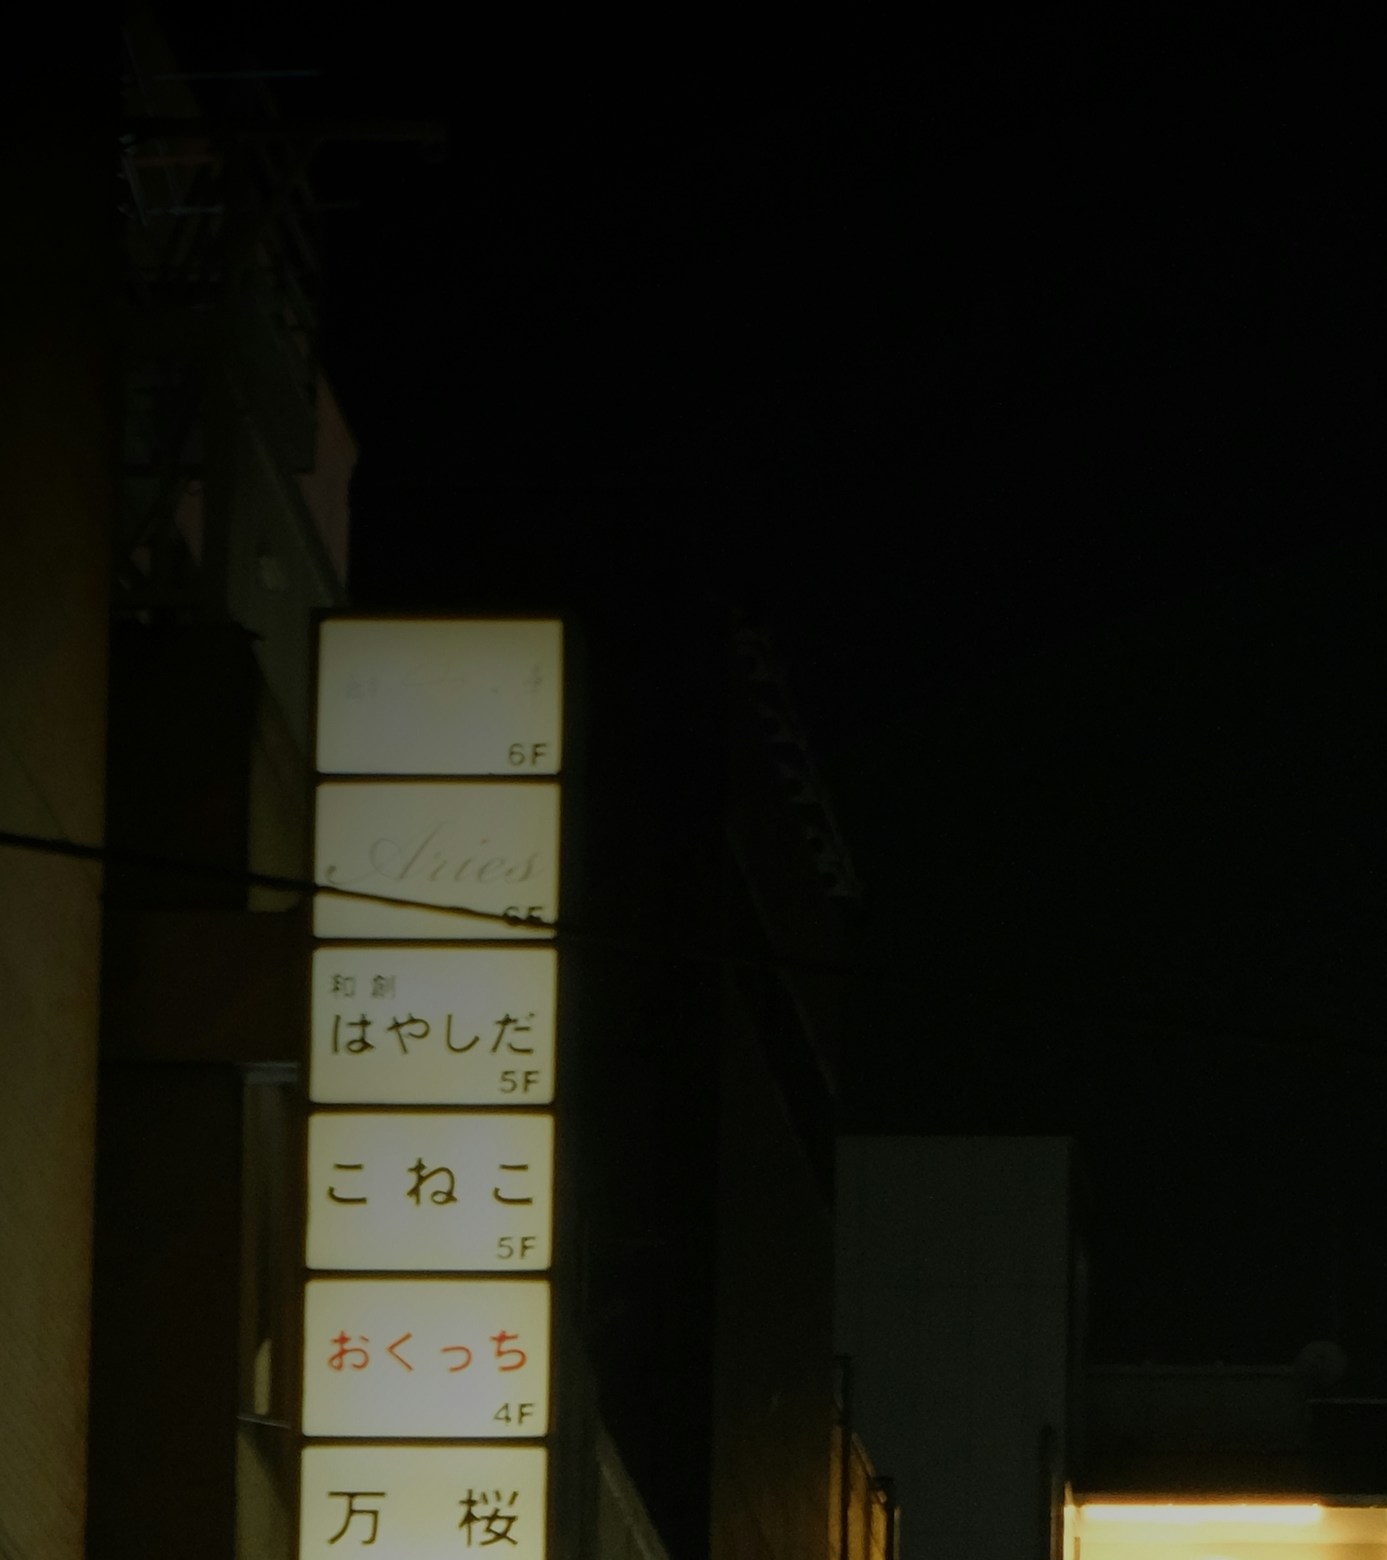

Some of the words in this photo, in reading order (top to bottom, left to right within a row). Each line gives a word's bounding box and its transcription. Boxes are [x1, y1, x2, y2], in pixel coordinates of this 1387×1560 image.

[508, 743, 547, 767] 6F
[326, 823, 545, 885] Aries
[331, 1013, 535, 1056] はやしだ
[499, 1071, 540, 1093] 5F
[328, 1157, 534, 1206] こねこ
[496, 1237, 537, 1259] 5F
[327, 1329, 528, 1372] おくっち
[493, 1404, 534, 1426] 4F
[327, 1487, 520, 1548] 万桜
